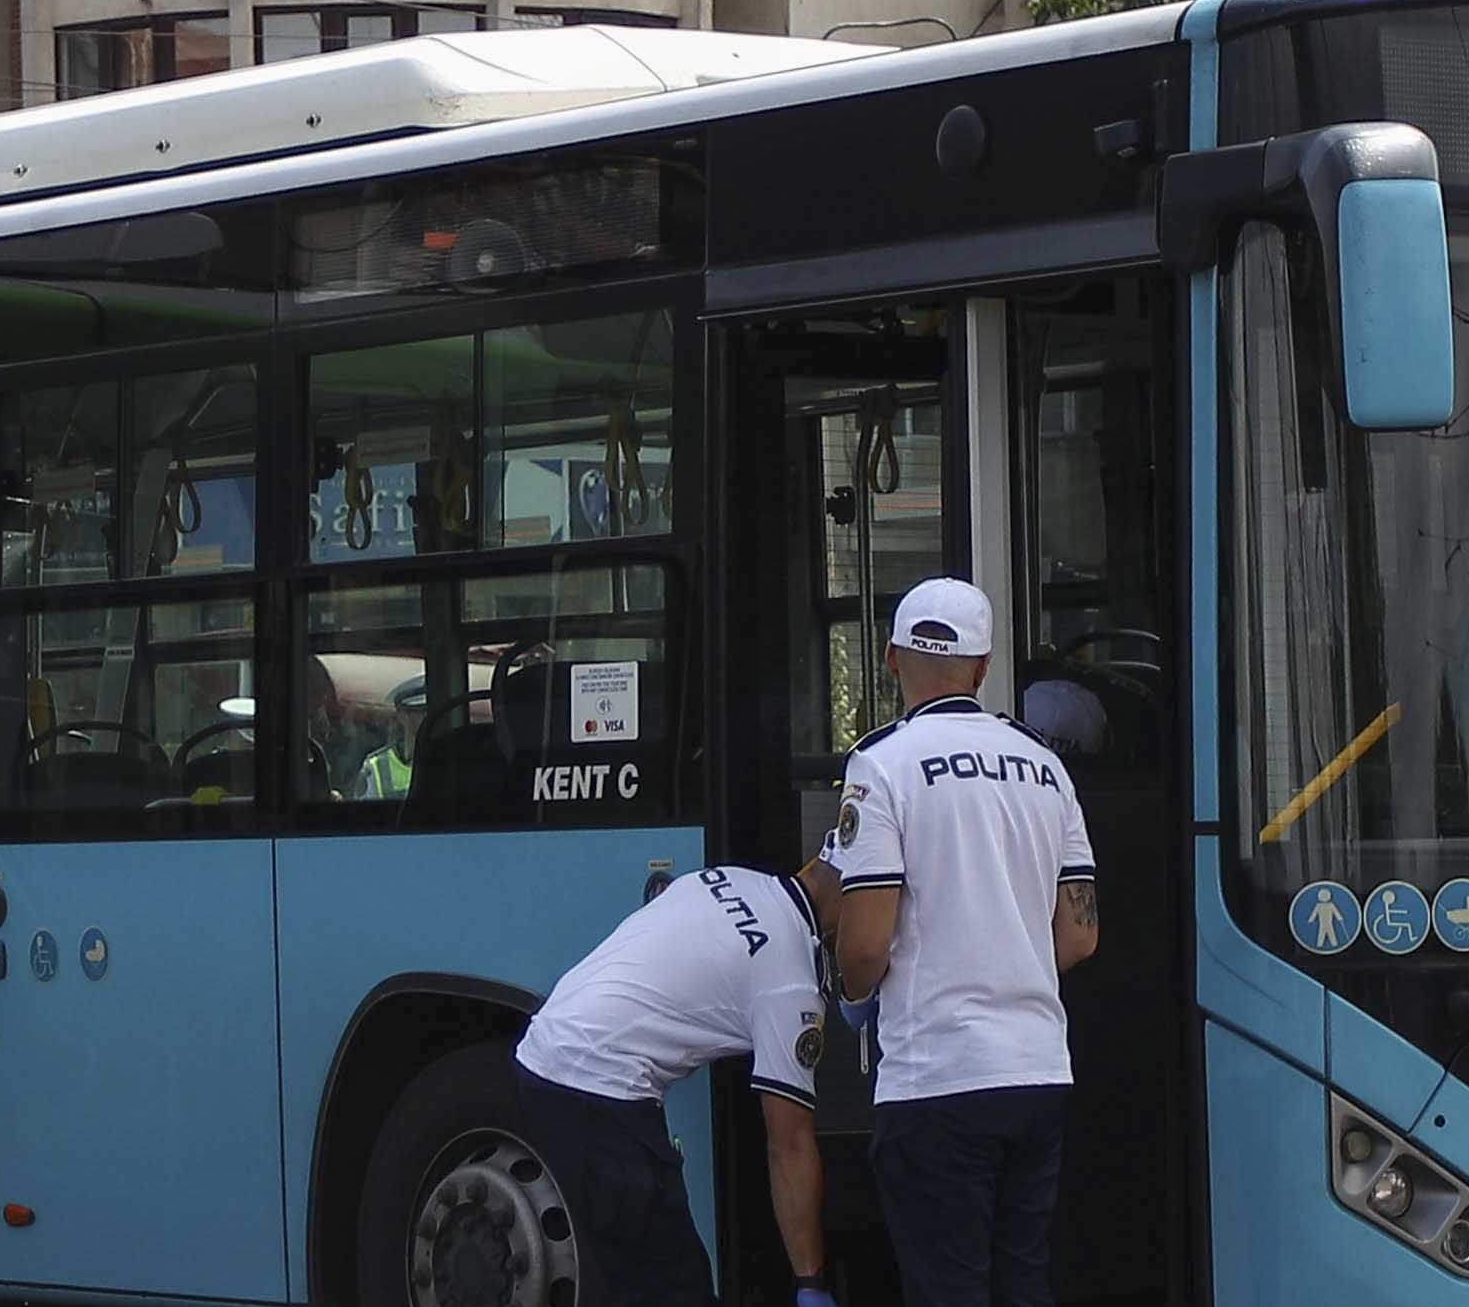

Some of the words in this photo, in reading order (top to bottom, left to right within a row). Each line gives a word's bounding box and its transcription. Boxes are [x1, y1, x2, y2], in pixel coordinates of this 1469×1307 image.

[910, 638, 950, 654] POLITIA
[603, 719, 626, 732] VISA
[532, 764, 611, 801] KENT
[617, 762, 639, 799] C
[920, 751, 1061, 793] POLITIA
[698, 867, 769, 959] OLITIA
